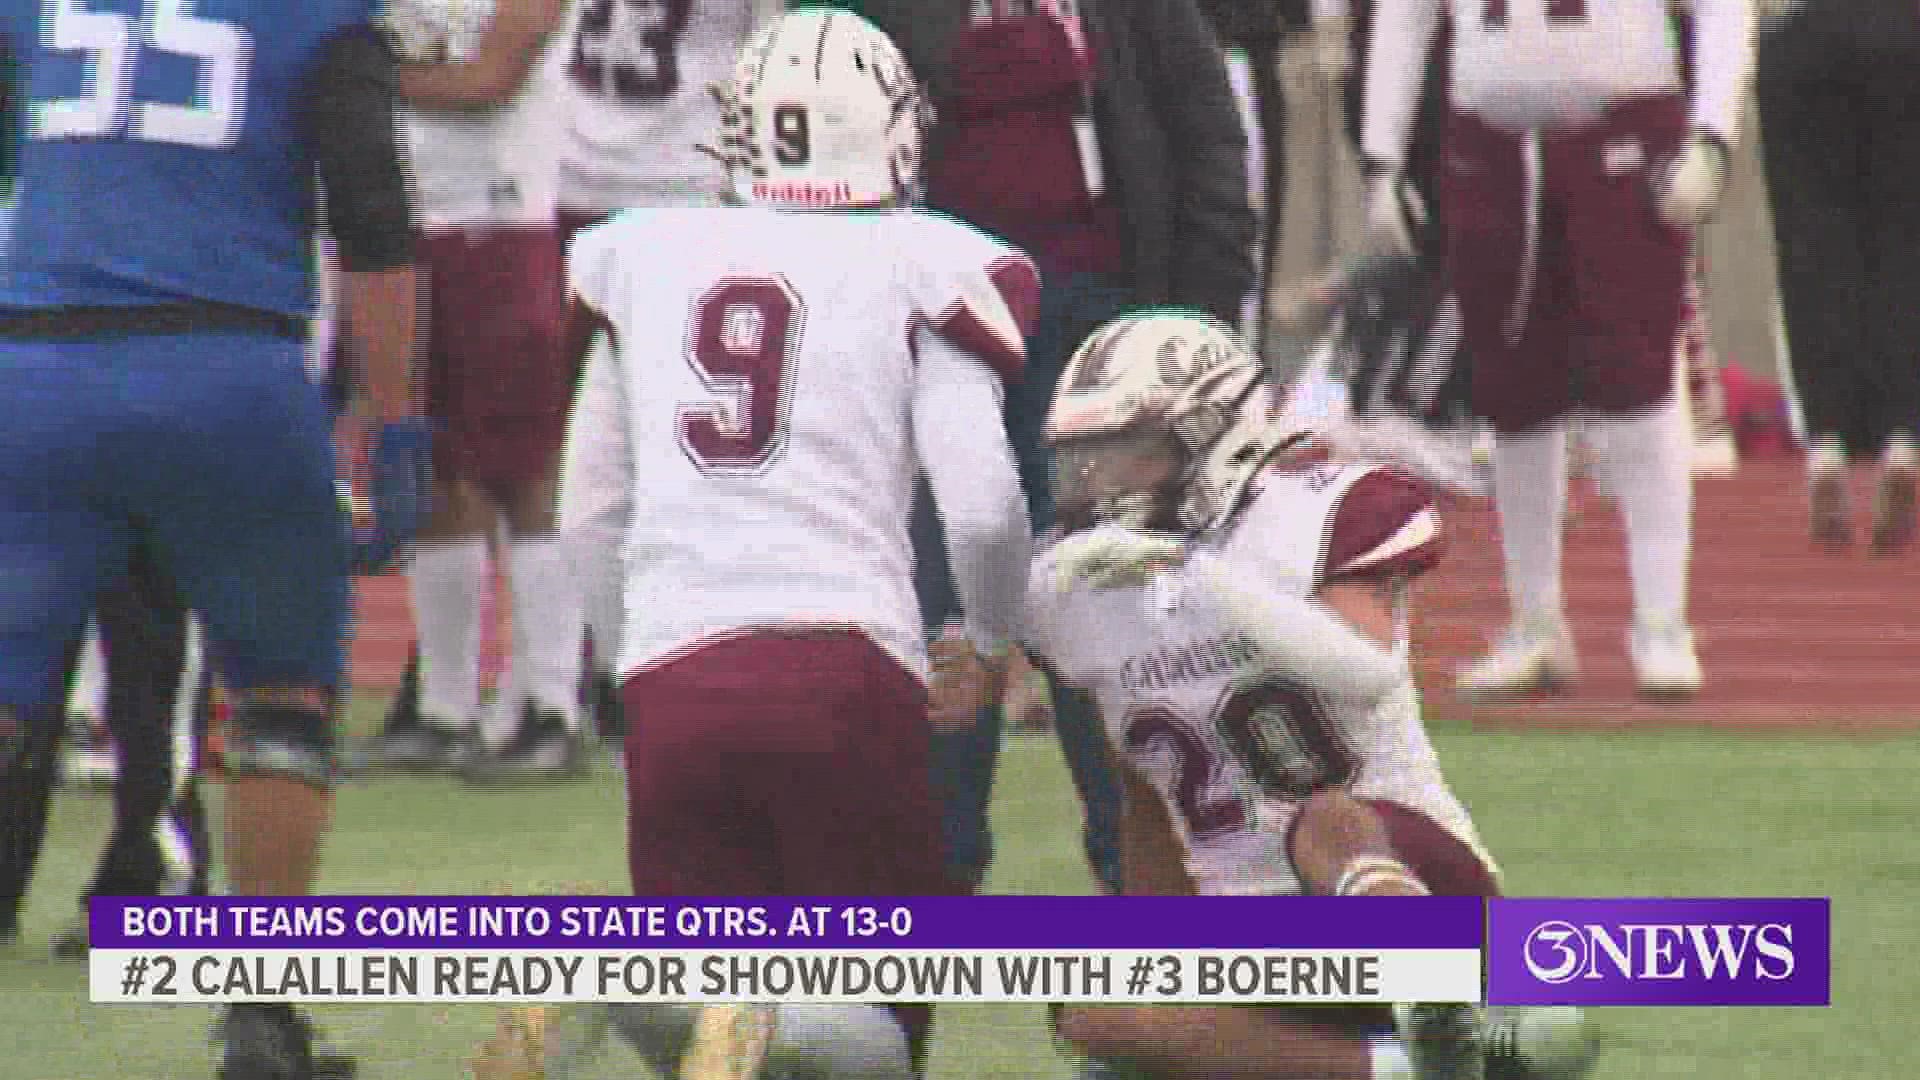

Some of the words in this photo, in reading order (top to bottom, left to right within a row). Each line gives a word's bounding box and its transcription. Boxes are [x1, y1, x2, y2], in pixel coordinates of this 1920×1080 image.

[26, 0, 253, 147] 55
[773, 103, 811, 166] 9
[674, 272, 808, 477] 9
[1118, 674, 1364, 840] 20
